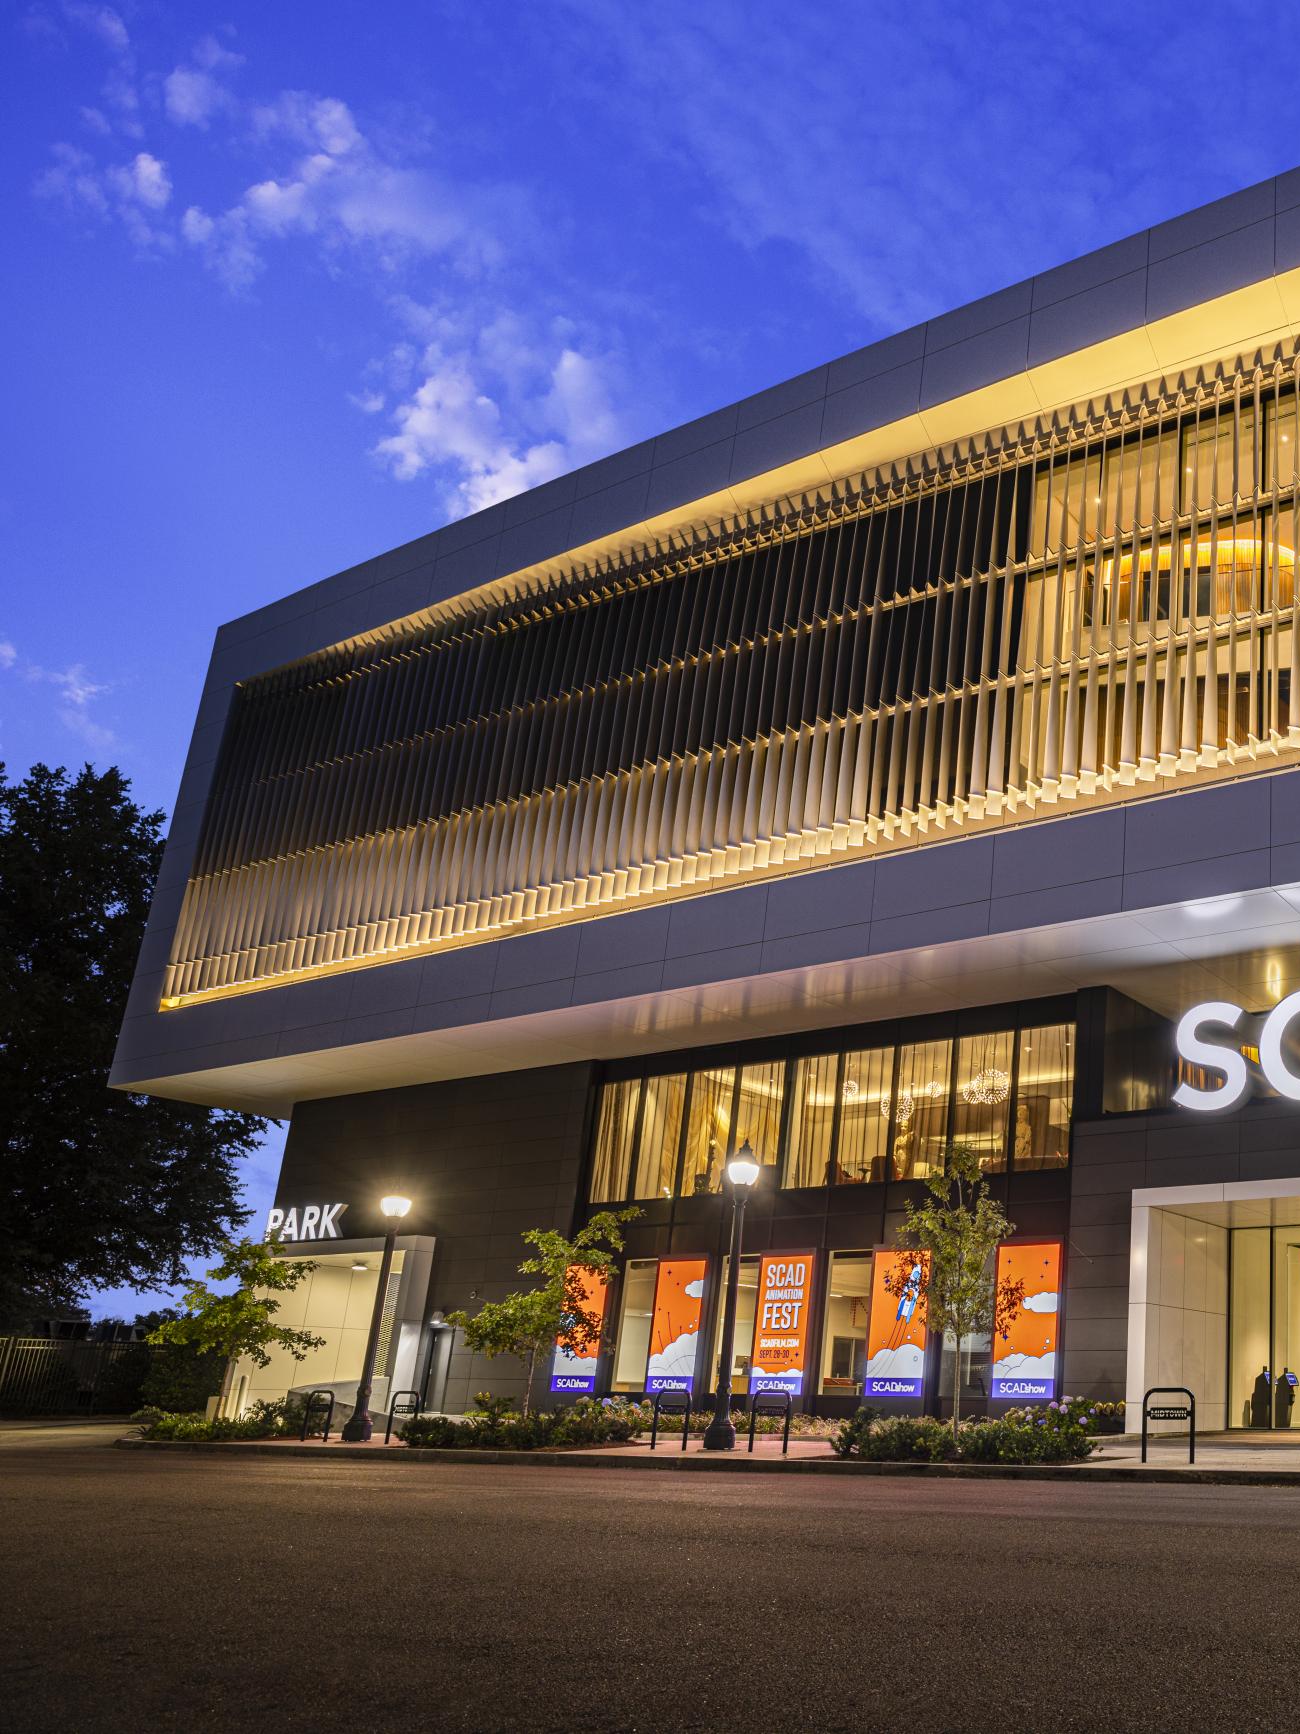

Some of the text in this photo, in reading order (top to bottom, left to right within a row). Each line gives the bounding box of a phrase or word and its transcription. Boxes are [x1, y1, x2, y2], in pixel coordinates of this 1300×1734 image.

[264, 1203, 345, 1242] PARK
[766, 1263, 806, 1288] SCAD
[765, 1288, 804, 1301] ANIMATION
[762, 1302, 803, 1330] FEST
[760, 1338, 800, 1348] SCADFILM.COM
[759, 1349, 773, 1359] SEPT.
[556, 1378, 590, 1389] SCADshow
[651, 1379, 688, 1390] SCADshow
[756, 1380, 796, 1391] SCADshow
[871, 1381, 915, 1393] SCADshow
[999, 1382, 1047, 1394] SCADshow
[1150, 1409, 1187, 1418] MIDTOWN
